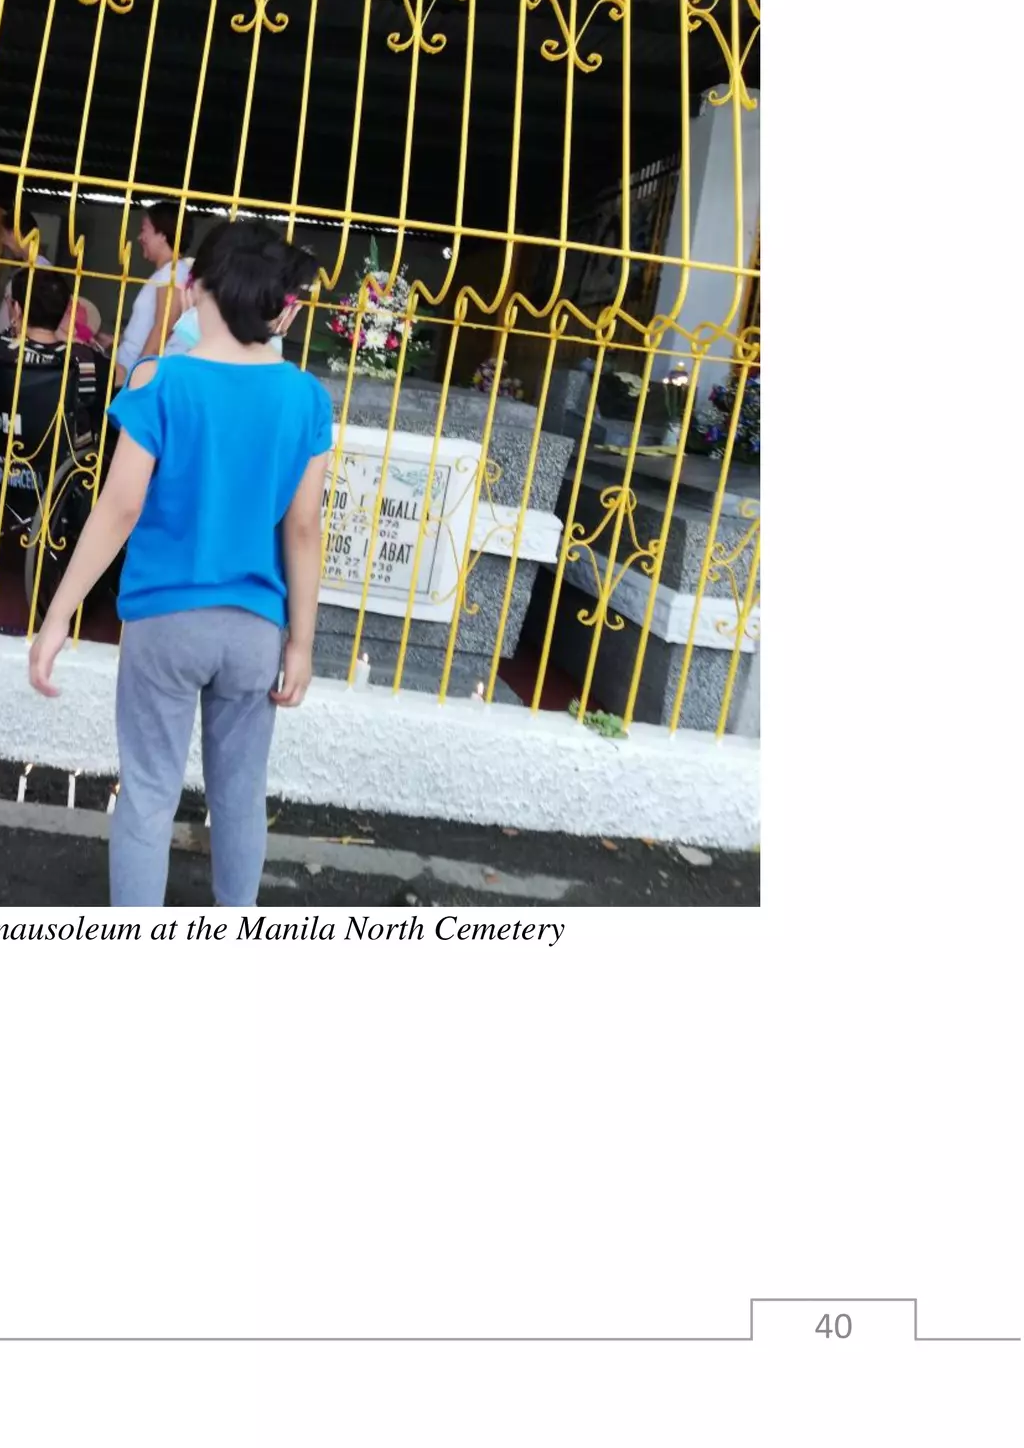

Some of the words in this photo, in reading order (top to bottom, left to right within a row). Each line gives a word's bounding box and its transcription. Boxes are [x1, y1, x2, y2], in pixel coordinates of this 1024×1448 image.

[151, 921, 178, 941] at
[187, 916, 227, 941] the
[236, 916, 335, 941] Manila
[345, 916, 424, 941] North
[435, 916, 564, 947] Cemetery
[815, 1314, 852, 1339] 40
